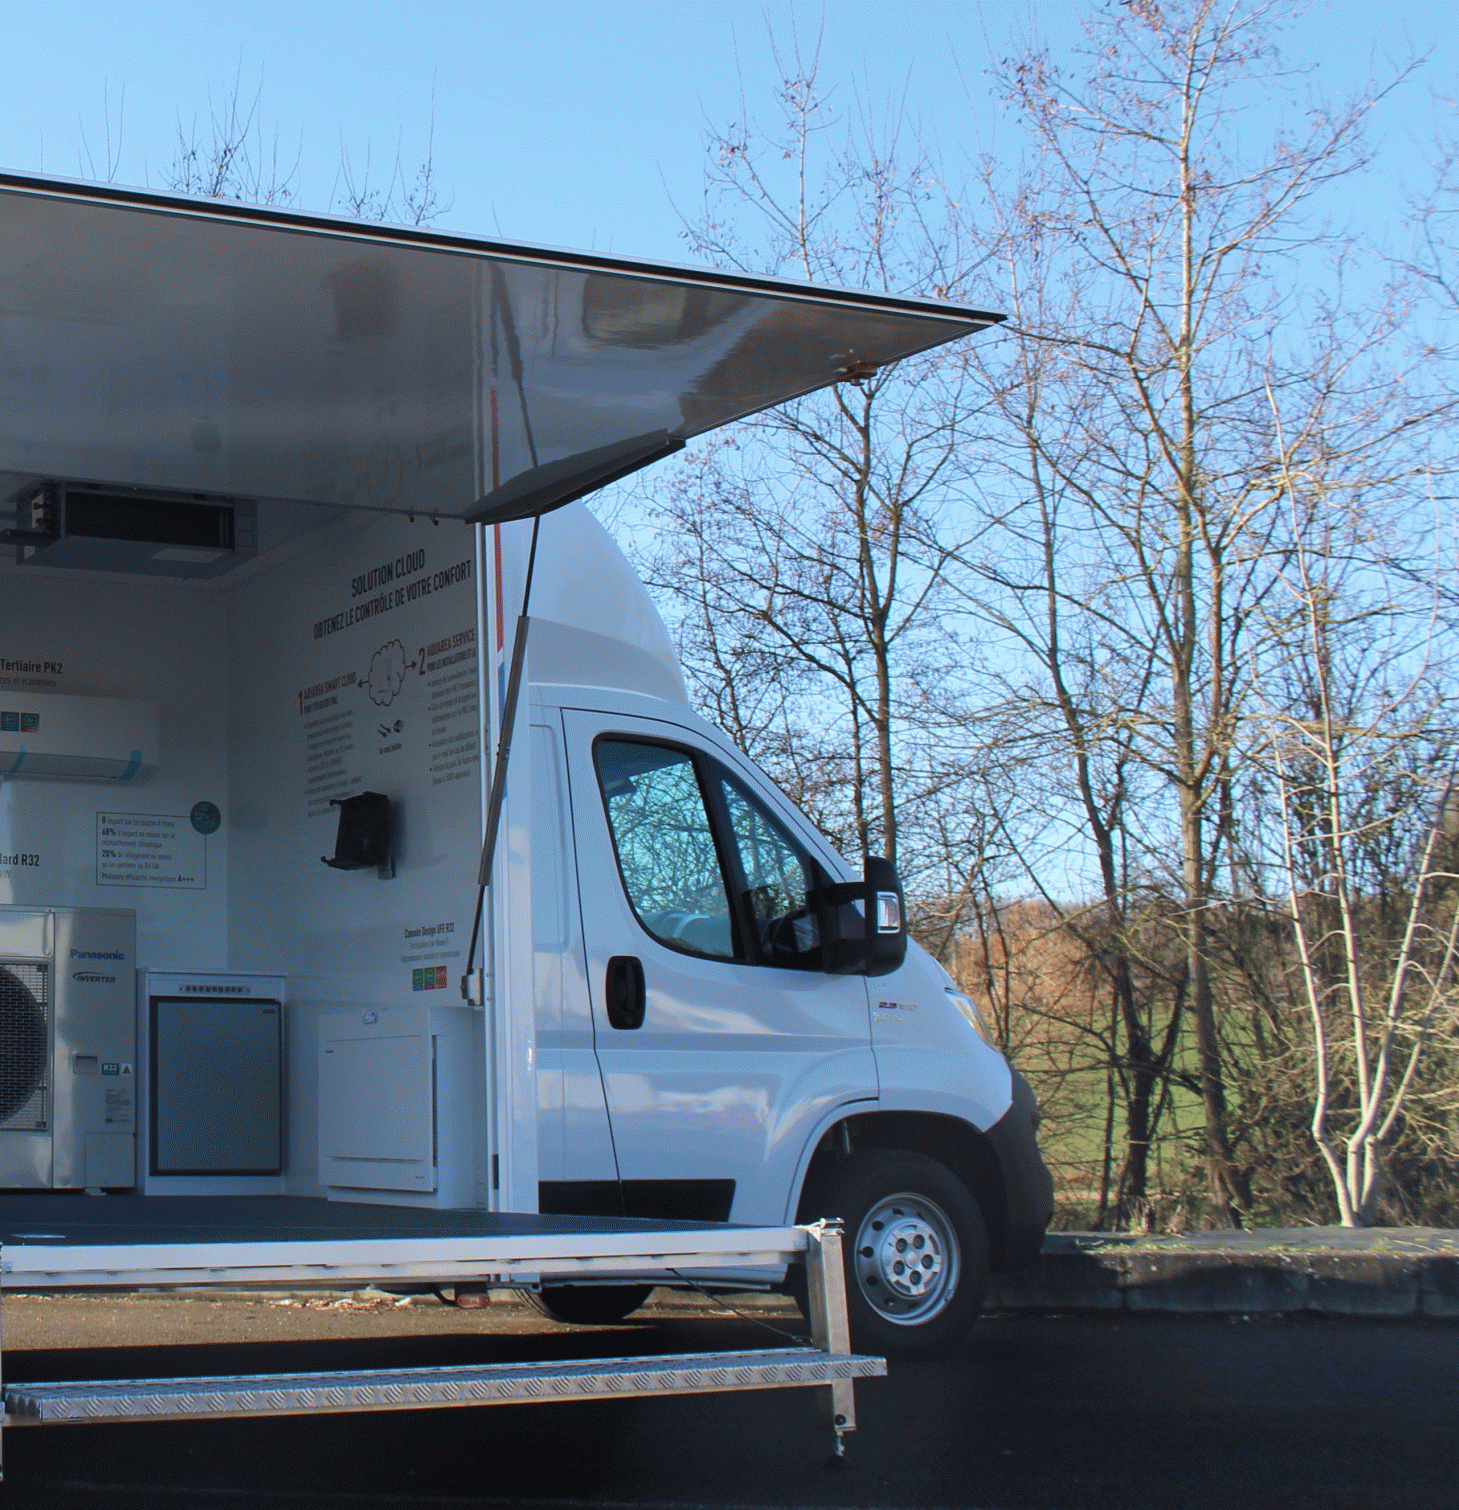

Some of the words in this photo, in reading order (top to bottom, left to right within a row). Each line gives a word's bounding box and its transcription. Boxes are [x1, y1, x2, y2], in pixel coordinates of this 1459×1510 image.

[352, 562, 393, 598] SOLUTION
[395, 549, 426, 579] CLOUD
[313, 612, 345, 640] OBTENEZ
[345, 609, 354, 627] LE
[395, 588, 405, 607] DE
[406, 576, 432, 602] VOTRE
[433, 560, 472, 591] CONFORT
[0, 658, 42, 673] Tertiaire
[43, 661, 63, 675] PK2
[419, 647, 425, 675] 2
[21, 854, 41, 867] R32
[70, 949, 125, 961] Panasonic
[76, 975, 116, 984] INVERTER
